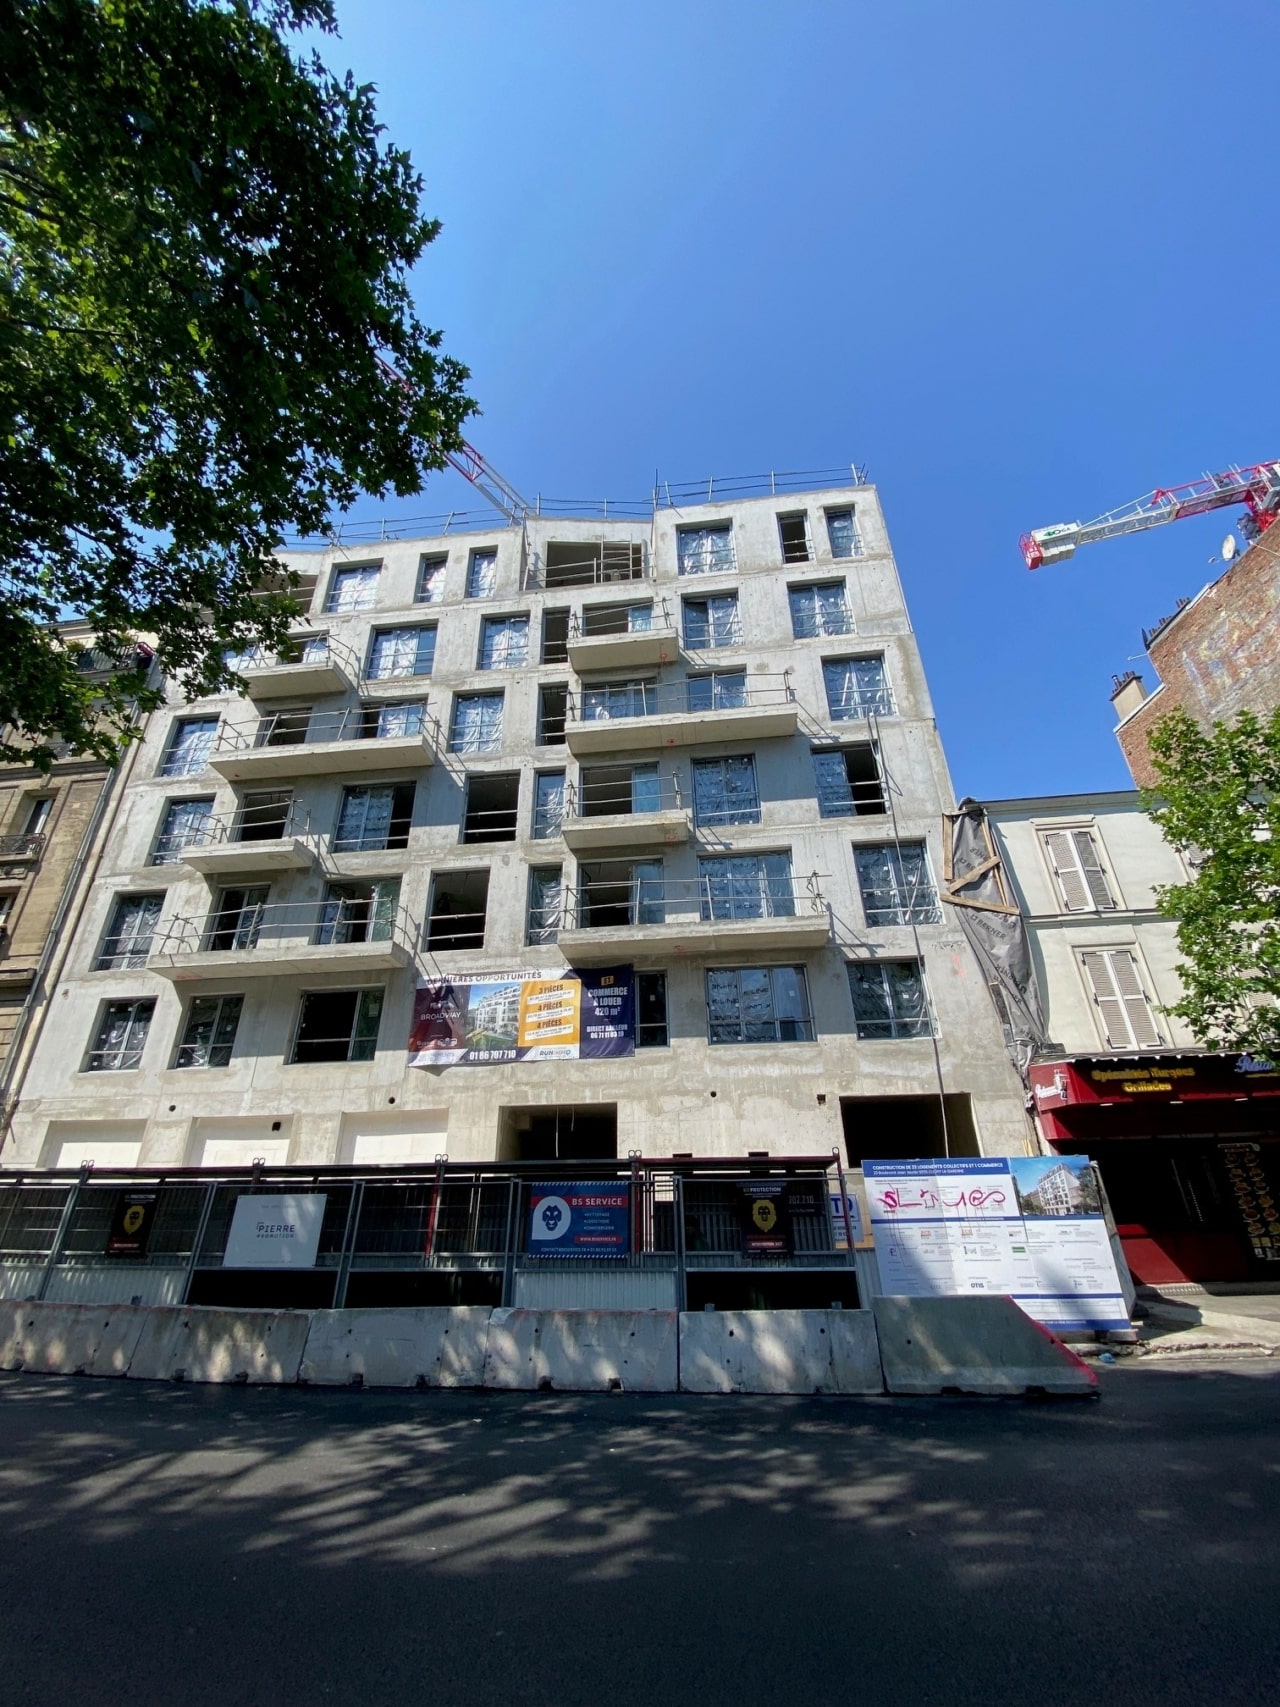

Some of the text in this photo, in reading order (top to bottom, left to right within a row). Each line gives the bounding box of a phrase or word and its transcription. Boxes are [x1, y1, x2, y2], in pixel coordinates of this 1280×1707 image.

[976, 918, 1007, 940] BERNER
[476, 970, 542, 983] OPPORTUNITÉS
[544, 984, 564, 993] PIÈCES
[587, 986, 629, 998] COMMERCE
[543, 1001, 563, 1011] PIÈCES
[600, 997, 623, 1006] LOUER
[420, 1011, 462, 1021] BROADWAY
[594, 1007, 610, 1016] 420
[542, 1018, 563, 1028] PIÈCES
[469, 1052, 479, 1060] 01
[503, 1049, 517, 1059] 710
[1123, 1080, 1172, 1093] Grillades
[571, 1198, 622, 1206] BS SERVICE
[258, 1224, 296, 1233] PIERRE
